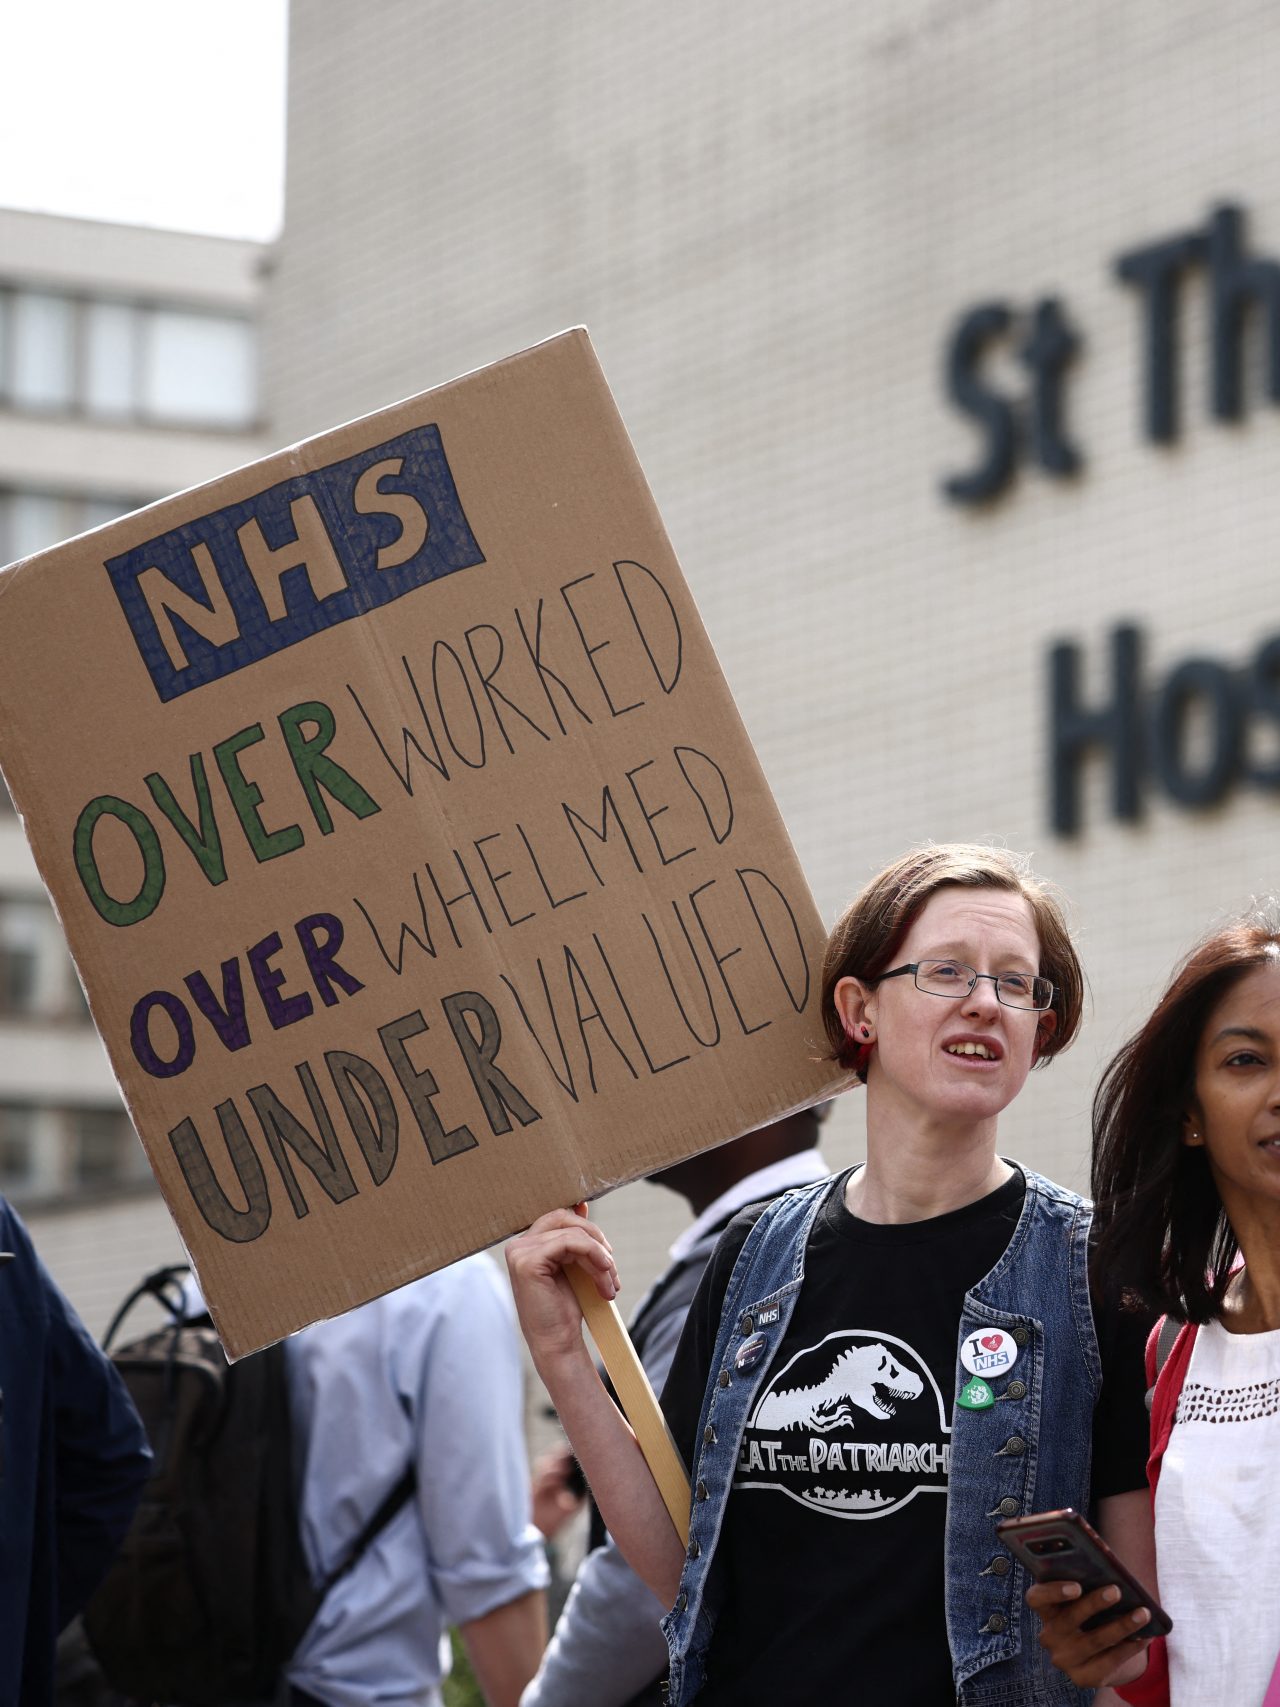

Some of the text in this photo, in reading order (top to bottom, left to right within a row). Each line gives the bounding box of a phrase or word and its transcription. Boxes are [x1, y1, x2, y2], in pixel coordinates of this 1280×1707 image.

[941, 292, 1084, 514] St
[132, 455, 430, 673] NHS
[759, 1309, 778, 1325] NHS
[969, 1338, 983, 1358] I
[976, 1352, 1007, 1371] NHS
[777, 1454, 809, 1471] THE
[809, 1437, 951, 1474] PATRIARCH
